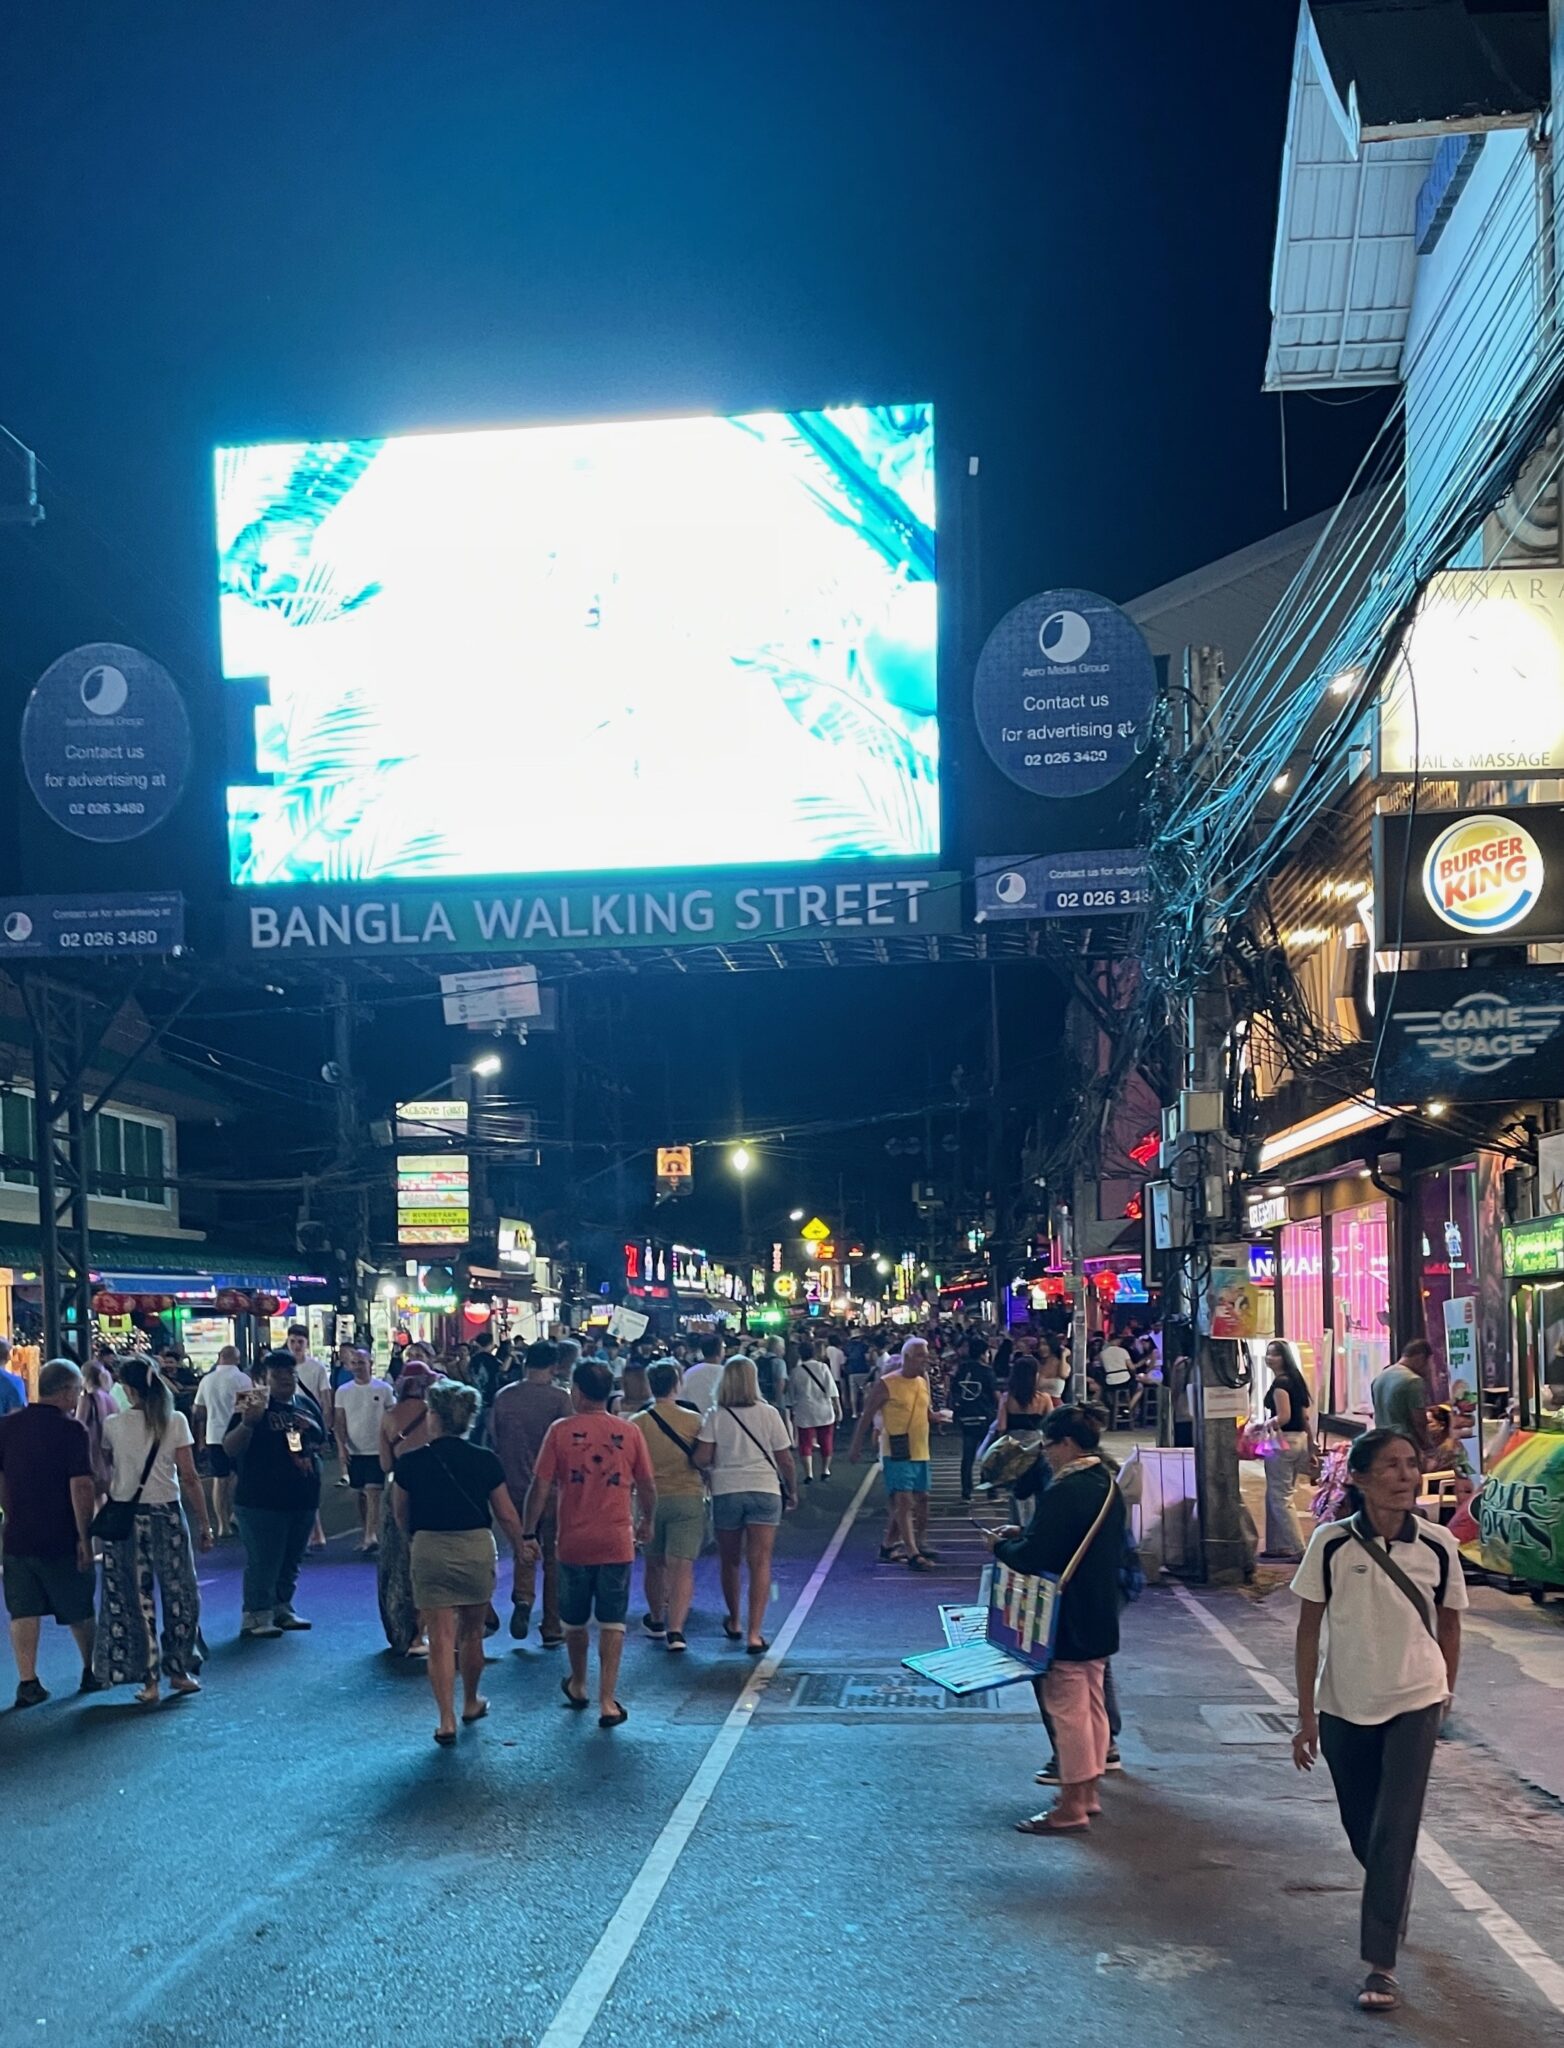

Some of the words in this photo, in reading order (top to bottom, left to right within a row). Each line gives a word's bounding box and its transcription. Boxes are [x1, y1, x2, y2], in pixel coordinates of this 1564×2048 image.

[1079, 662, 1110, 675] Group
[1023, 694, 1085, 711] Contact
[1090, 694, 1110, 707] us
[1001, 727, 1023, 742] for
[1027, 721, 1113, 739] advertising
[65, 745, 123, 760] Contact
[126, 747, 145, 759] us
[1024, 754, 1042, 766] 02
[1044, 752, 1071, 765] 026
[1469, 751, 1551, 768] MASSAGE
[44, 773, 64, 788] for
[67, 772, 148, 790] advertising
[151, 774, 167, 787] at
[69, 803, 86, 815] 02
[88, 803, 112, 815] 026
[1439, 836, 1524, 881] BURGER
[1049, 869, 1086, 880] Contact
[1087, 868, 1099, 878] us
[1100, 867, 1114, 877] for
[1443, 855, 1528, 911] KING
[1056, 893, 1079, 908] 02
[1082, 891, 1115, 907] 026
[251, 902, 457, 948] BANGLA
[472, 889, 714, 941] WALKING
[734, 881, 930, 930] STREET
[59, 932, 80, 947] 02
[83, 931, 114, 946] 026
[117, 930, 158, 946] 3480
[1441, 1006, 1525, 1031] GAME
[1440, 1034, 1527, 1057] SPACE
